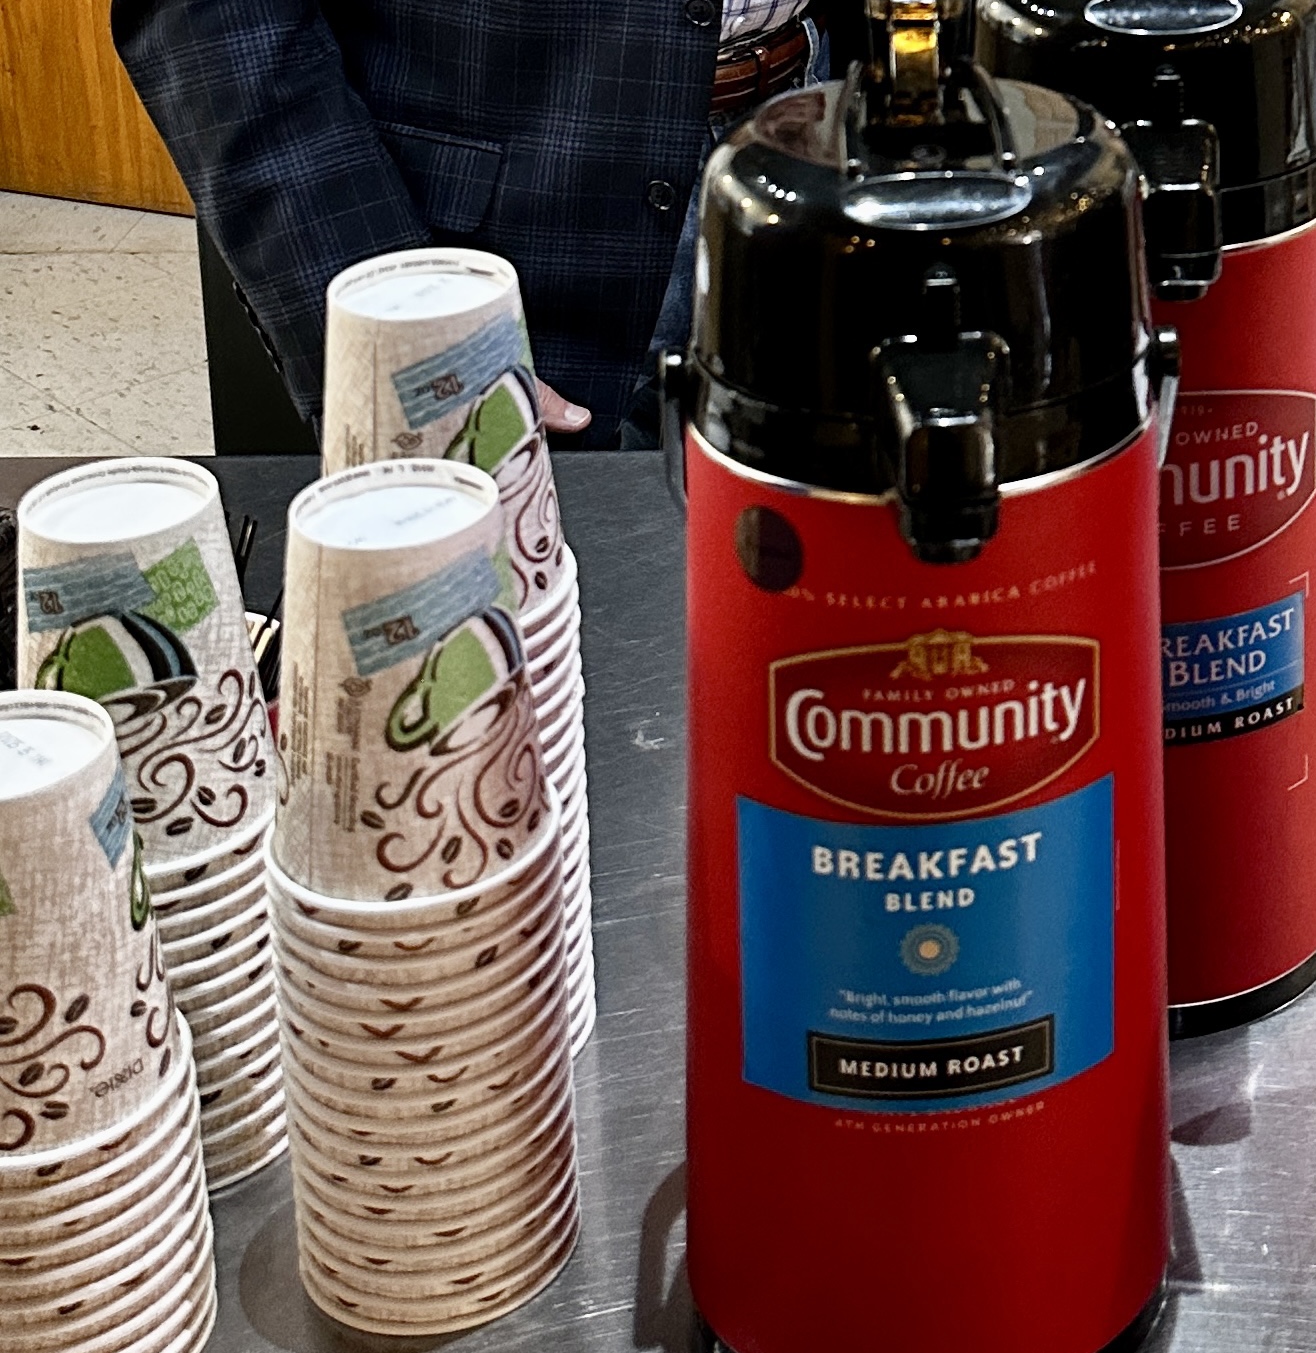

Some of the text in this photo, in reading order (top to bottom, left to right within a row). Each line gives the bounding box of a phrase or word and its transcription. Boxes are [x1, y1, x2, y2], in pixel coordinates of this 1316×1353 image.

[432, 373, 464, 401] 12
[1175, 421, 1259, 446] OWNED
[1160, 514, 1241, 537] FEE
[825, 591, 907, 610] SELECT
[921, 585, 1021, 609] ARABICA
[1029, 560, 1096, 596] COFFEE
[38, 590, 63, 615] 12
[382, 615, 420, 645] 12
[1161, 607, 1295, 659] REAKFAST
[1169, 650, 1267, 687] BLEND
[862, 679, 1016, 703] FAMILY OWNED
[1163, 680, 1276, 712] mooth & Bright
[785, 677, 1087, 761] Community
[1165, 696, 1294, 740] DIUM ROAST
[889, 758, 990, 799] Coffee
[811, 832, 1043, 881] BREAKFAST
[885, 887, 976, 913] BLEND
[893, 990, 947, 1007] smooth
[948, 986, 988, 1002] flavor
[992, 978, 1022, 994] with
[828, 1007, 868, 1023] notes
[870, 1009, 885, 1024] of
[888, 1010, 933, 1025] honey
[936, 1006, 964, 1022] and
[838, 1045, 1024, 1079] MEDIUM ROAST
[835, 1118, 865, 1130] 4TH
[871, 1118, 982, 1133] GENERATION
[988, 1100, 1045, 1125] OWNER
